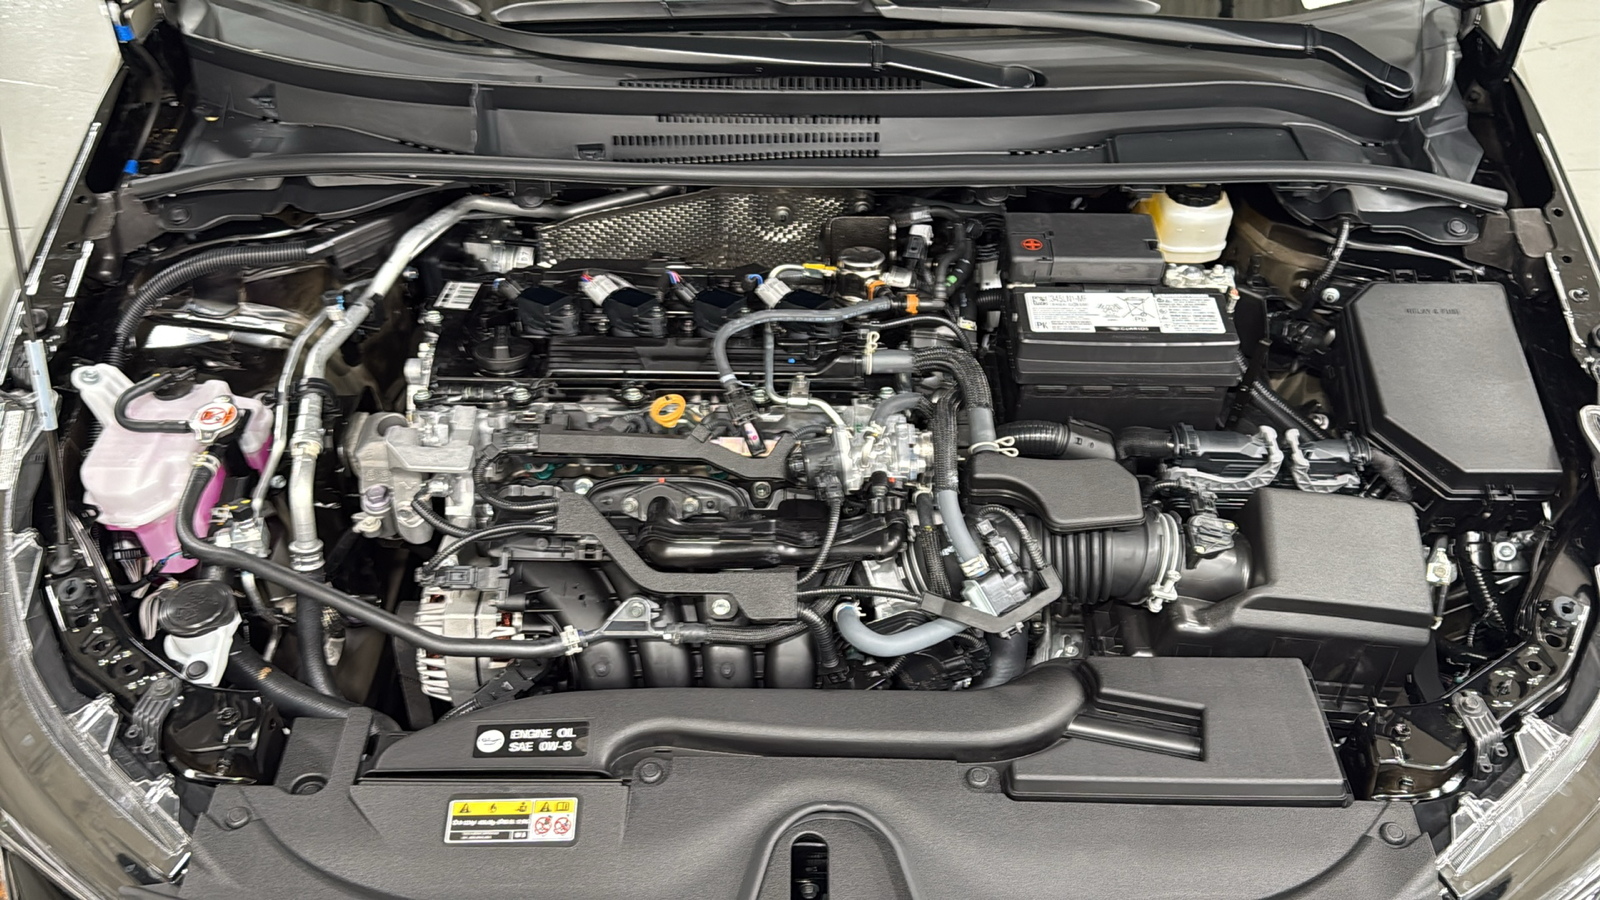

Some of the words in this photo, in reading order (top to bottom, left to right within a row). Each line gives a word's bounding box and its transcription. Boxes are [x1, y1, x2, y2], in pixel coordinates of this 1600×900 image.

[510, 728, 553, 740] ENGINE
[556, 727, 577, 738] OIL
[508, 741, 534, 752] SAE
